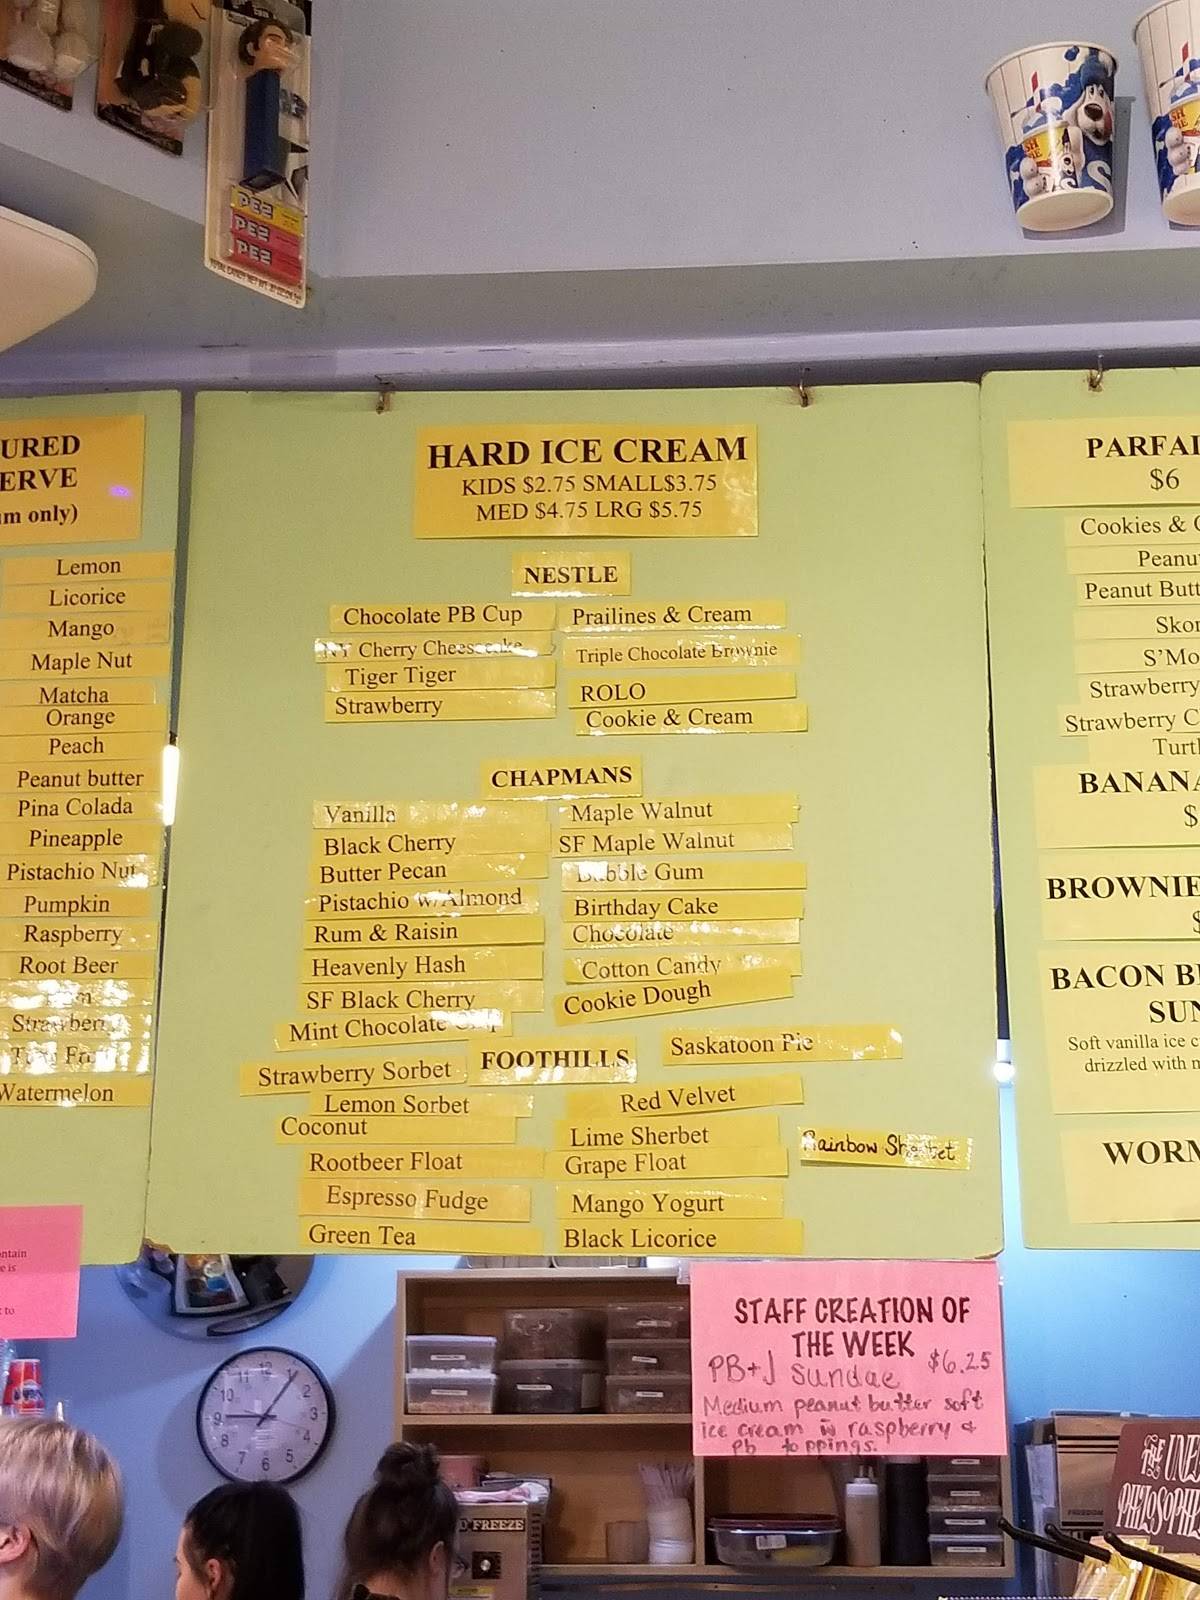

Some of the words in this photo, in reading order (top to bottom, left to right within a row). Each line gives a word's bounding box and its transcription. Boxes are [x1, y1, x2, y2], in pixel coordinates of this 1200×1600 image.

[238, 191, 273, 219] PEZ
[234, 214, 270, 242] PEZ
[236, 238, 272, 265] PEZ
[427, 440, 530, 469] HARD
[540, 438, 602, 464] ICE
[613, 436, 748, 463] CREAM
[462, 478, 516, 496] KIDS
[523, 475, 575, 494] $2.75
[28, 503, 78, 526] only)
[476, 503, 529, 522] MED
[535, 501, 588, 520] $4.75
[595, 501, 642, 519] LRG
[649, 500, 702, 519] $5.75
[1080, 516, 1162, 535] Cookies
[1169, 515, 1187, 533] &
[56, 560, 121, 576] Lemon
[1138, 550, 1200, 567] Peanu
[523, 565, 618, 585] NESTLE
[49, 589, 126, 607] Licorice
[1085, 580, 1152, 600] Peanut
[343, 607, 441, 626] Chocolate
[447, 606, 476, 623] PB
[483, 605, 523, 626] Cup
[572, 607, 656, 626] Prailines
[663, 606, 680, 623] &
[688, 605, 752, 623] Cream
[48, 620, 115, 640] Mango
[359, 642, 418, 661] Cherry
[576, 649, 623, 666] Triple
[628, 645, 706, 661] Chocolate
[712, 641, 778, 658] Brownie
[31, 654, 91, 673] Maple
[97, 652, 133, 669] Nut
[345, 668, 398, 690] Tiger
[403, 666, 457, 687] Tiger
[1090, 678, 1200, 699] Strawberry
[39, 687, 109, 704] Matcha
[580, 683, 646, 702] ROLO
[335, 696, 444, 717] Strawberry
[46, 709, 116, 729] Orange
[586, 709, 656, 728] Cookie
[663, 708, 681, 726] &
[688, 707, 753, 725] Cream
[1065, 712, 1176, 732] Strawberry
[49, 737, 104, 755] Peach
[17, 771, 80, 788] Peanut
[87, 769, 144, 787] butter
[491, 766, 632, 788] CHAPMANS
[18, 800, 59, 817] Pina
[65, 797, 133, 816] Colada
[324, 805, 396, 824] Vanilla
[571, 803, 634, 826] Maple
[640, 801, 713, 820] Walnut
[29, 829, 123, 849] Pineapple
[324, 836, 381, 856] Black
[388, 834, 457, 855] Cherry
[559, 835, 585, 853] SF
[593, 833, 656, 855] Maple
[662, 832, 735, 850] Walnut
[7, 863, 94, 881] Pistachio
[102, 862, 137, 879] Nut
[320, 865, 382, 884] Butter
[388, 862, 447, 881] Pecan
[655, 862, 704, 881] Gum
[1046, 876, 1200, 900] BROWNIE
[24, 895, 110, 916] Pumpkin
[318, 893, 409, 913] Pistachio
[574, 898, 661, 919] Birthday
[668, 897, 719, 915] Cake
[23, 925, 123, 948] Raspberry
[314, 925, 362, 944] Rum
[369, 924, 387, 942] &
[395, 922, 459, 941] Raisin
[573, 924, 674, 943] Chocolate
[19, 957, 66, 974] Root
[73, 957, 119, 973] Beer
[312, 956, 408, 979] Heavenly
[415, 954, 466, 974] Hash
[582, 961, 650, 980] Cotton
[656, 955, 722, 976] Candy
[1051, 964, 1164, 990] BACON
[306, 991, 333, 1010] SF
[341, 991, 399, 1010] Black
[406, 989, 476, 1011] Cherry
[564, 990, 637, 1016] Cookie
[642, 980, 712, 1005] Dough
[289, 1022, 338, 1042] Mint
[345, 1015, 447, 1038] Chocolate
[671, 1036, 774, 1056] Saskatoon
[782, 1032, 813, 1052] Pie
[1068, 1036, 1102, 1051] Soft
[1105, 1034, 1159, 1050] vanilla
[1163, 1033, 1186, 1048] ice
[481, 1050, 630, 1069] FOOTHILLS
[1085, 1057, 1147, 1072] drizzled
[1151, 1055, 1186, 1070] with
[258, 1064, 375, 1087] Strawberry
[382, 1060, 451, 1081] Sorbet
[0, 1083, 114, 1101] Watermelon
[620, 1091, 661, 1114] Red
[666, 1085, 736, 1108] Velvet
[324, 1094, 395, 1114] Lemon
[403, 1095, 470, 1114] Sorbet
[281, 1116, 368, 1136] Coconut
[570, 1127, 625, 1148] Lime
[632, 1125, 709, 1146] Sherbet
[803, 1130, 877, 1154] Rainbow
[309, 1152, 404, 1172] Rootbeer
[409, 1151, 463, 1170] Float
[564, 1154, 628, 1176] Grape
[635, 1151, 687, 1172] Float
[326, 1185, 417, 1210] Espresso
[424, 1189, 489, 1215] Fudge
[571, 1194, 645, 1218] Mango
[653, 1192, 724, 1218] Yogurt
[308, 1224, 370, 1244] Green
[378, 1226, 416, 1245] Tea
[564, 1228, 624, 1248] Black
[630, 1227, 717, 1248] Licorice
[734, 1297, 807, 1324] STAFF
[815, 1296, 933, 1324] CREATION
[942, 1296, 970, 1323] OF
[792, 1330, 834, 1358] THE
[842, 1329, 915, 1358] WEEK
[790, 1363, 900, 1389] Sundae
[928, 1348, 992, 1374] $6.25
[703, 1396, 783, 1417] Medium
[794, 1397, 861, 1419] peanut
[869, 1391, 932, 1412] butter
[944, 1388, 984, 1412] soft
[702, 1421, 728, 1438] ice
[737, 1421, 803, 1438] cream
[848, 1418, 951, 1443] raspberry
[473, 1519, 525, 1531] FREEZE
